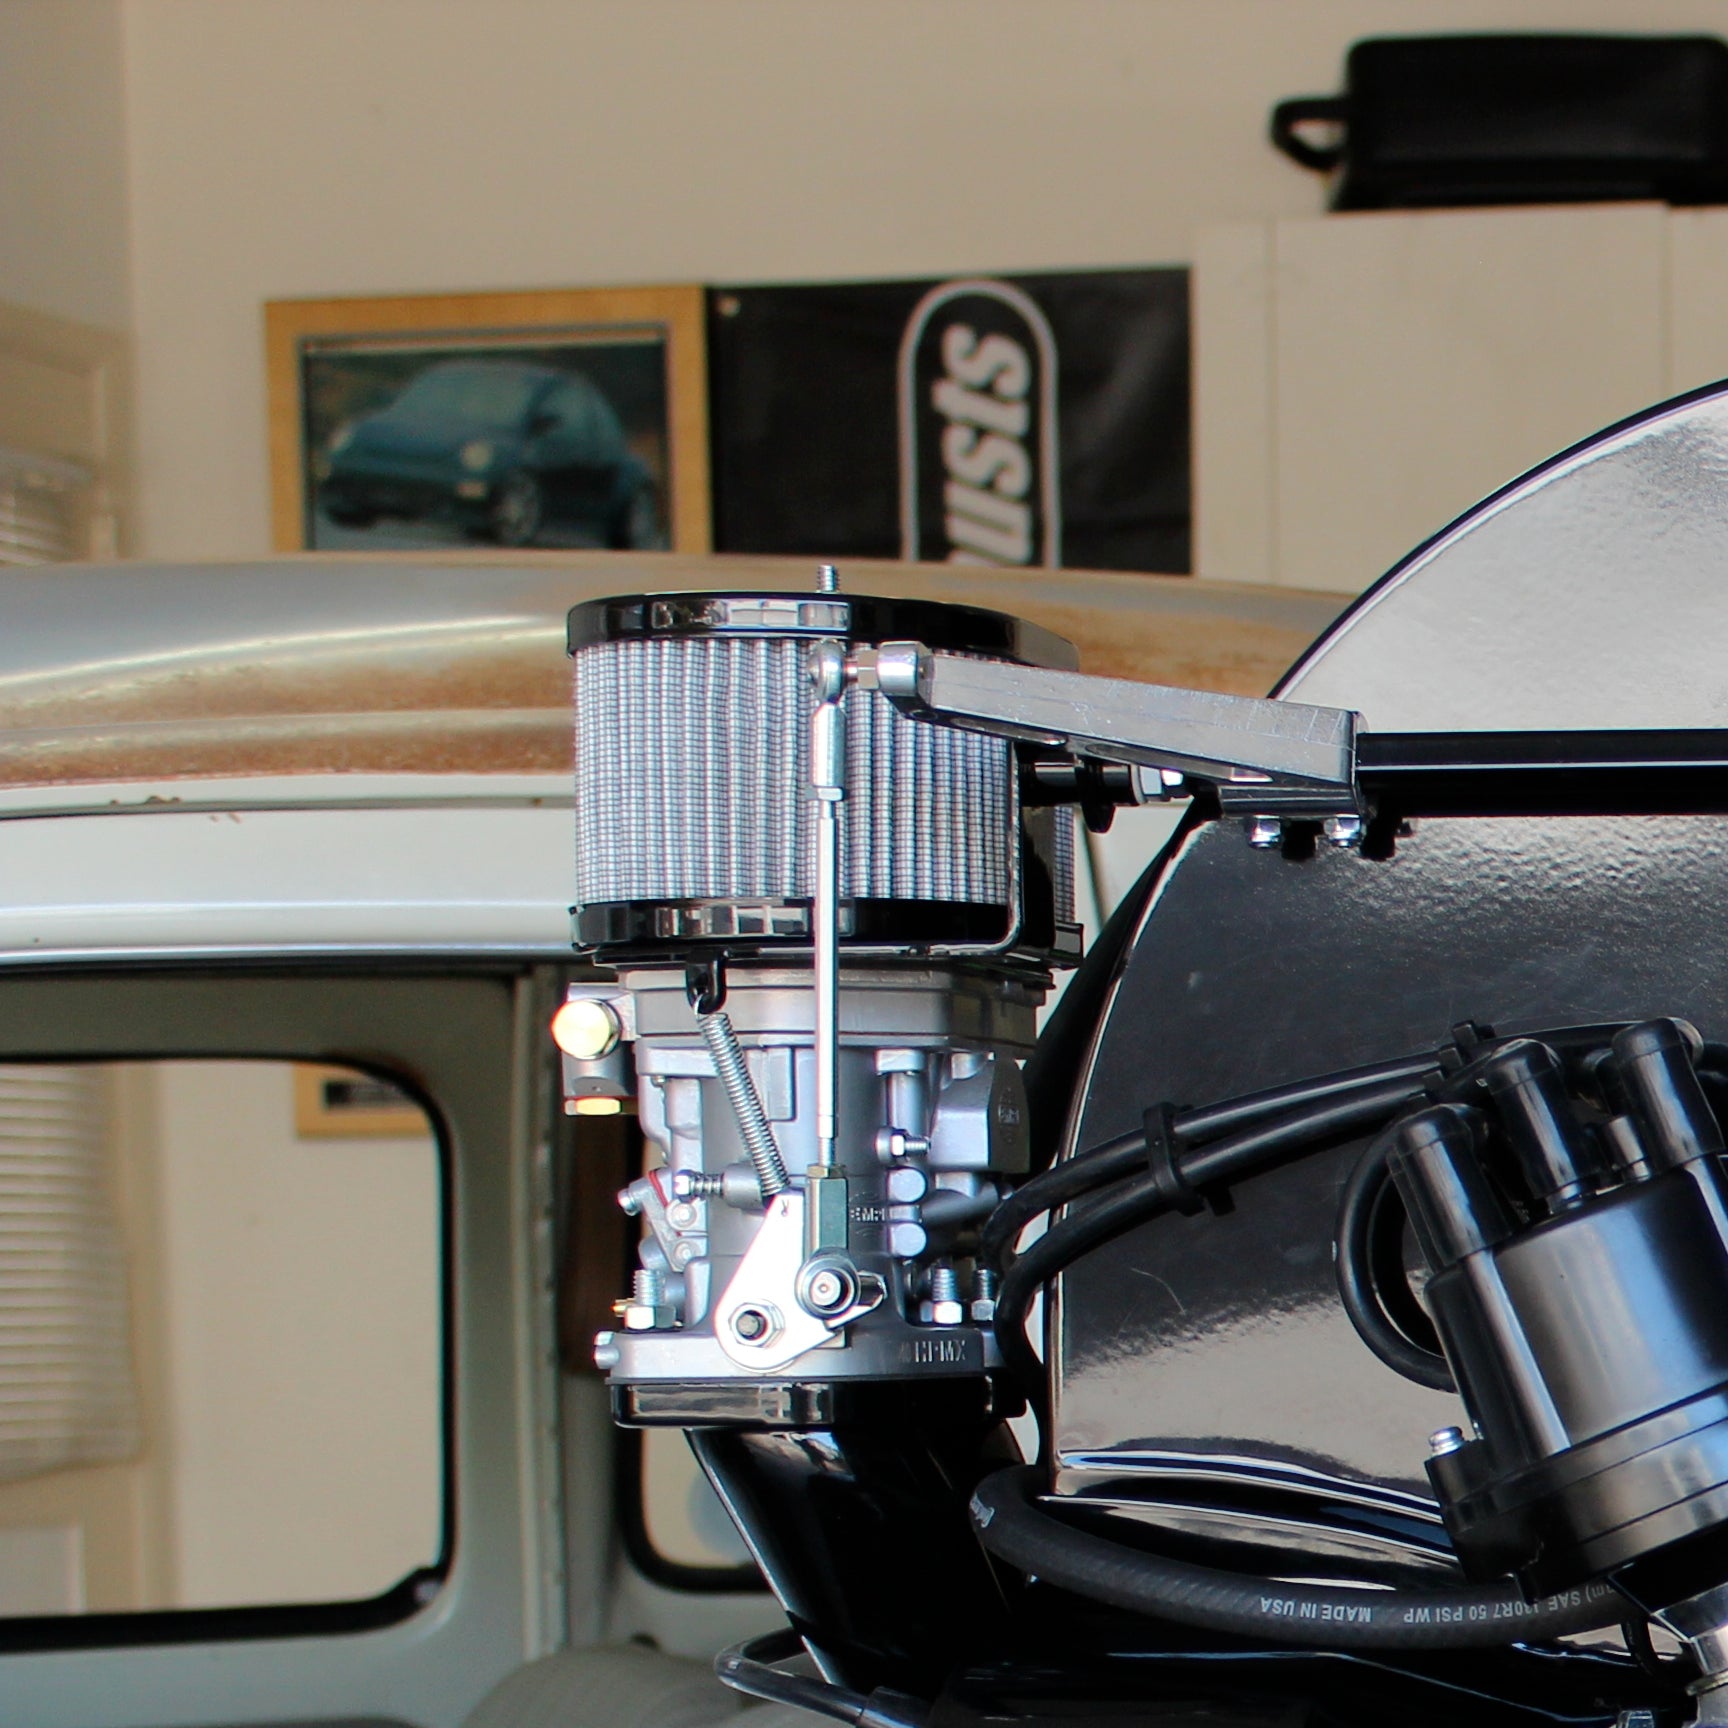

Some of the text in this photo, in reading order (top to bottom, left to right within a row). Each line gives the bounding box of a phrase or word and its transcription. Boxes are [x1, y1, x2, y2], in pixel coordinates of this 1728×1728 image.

[1260, 1596, 1294, 1616] USA
[1548, 1590, 1581, 1612] SAE
[1300, 1602, 1317, 1619] IN
[1321, 1604, 1371, 1623] MADE
[1403, 1607, 1431, 1624] WP
[1435, 1606, 1463, 1623] PSI
[1469, 1605, 1488, 1621] 50
